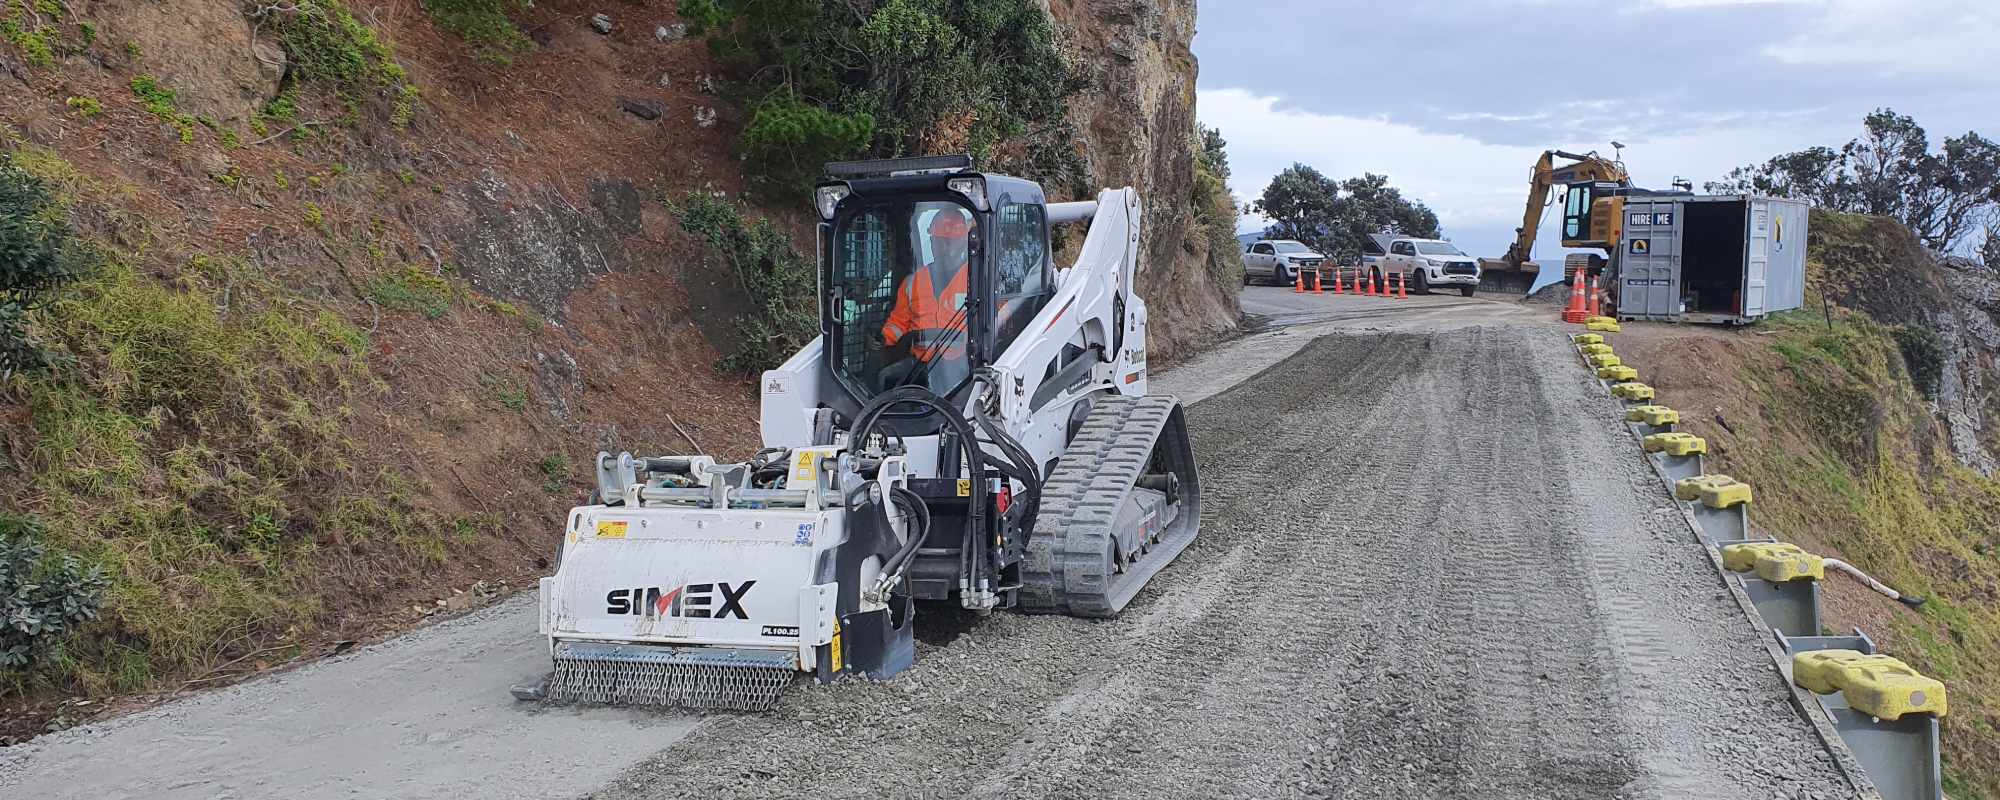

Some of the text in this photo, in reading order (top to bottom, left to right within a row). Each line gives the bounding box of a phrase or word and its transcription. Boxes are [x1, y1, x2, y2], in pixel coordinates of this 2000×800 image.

[1631, 213, 1670, 225] HIRE ME
[606, 580, 757, 620] SIMEX
[762, 627, 799, 636] PL100.25
